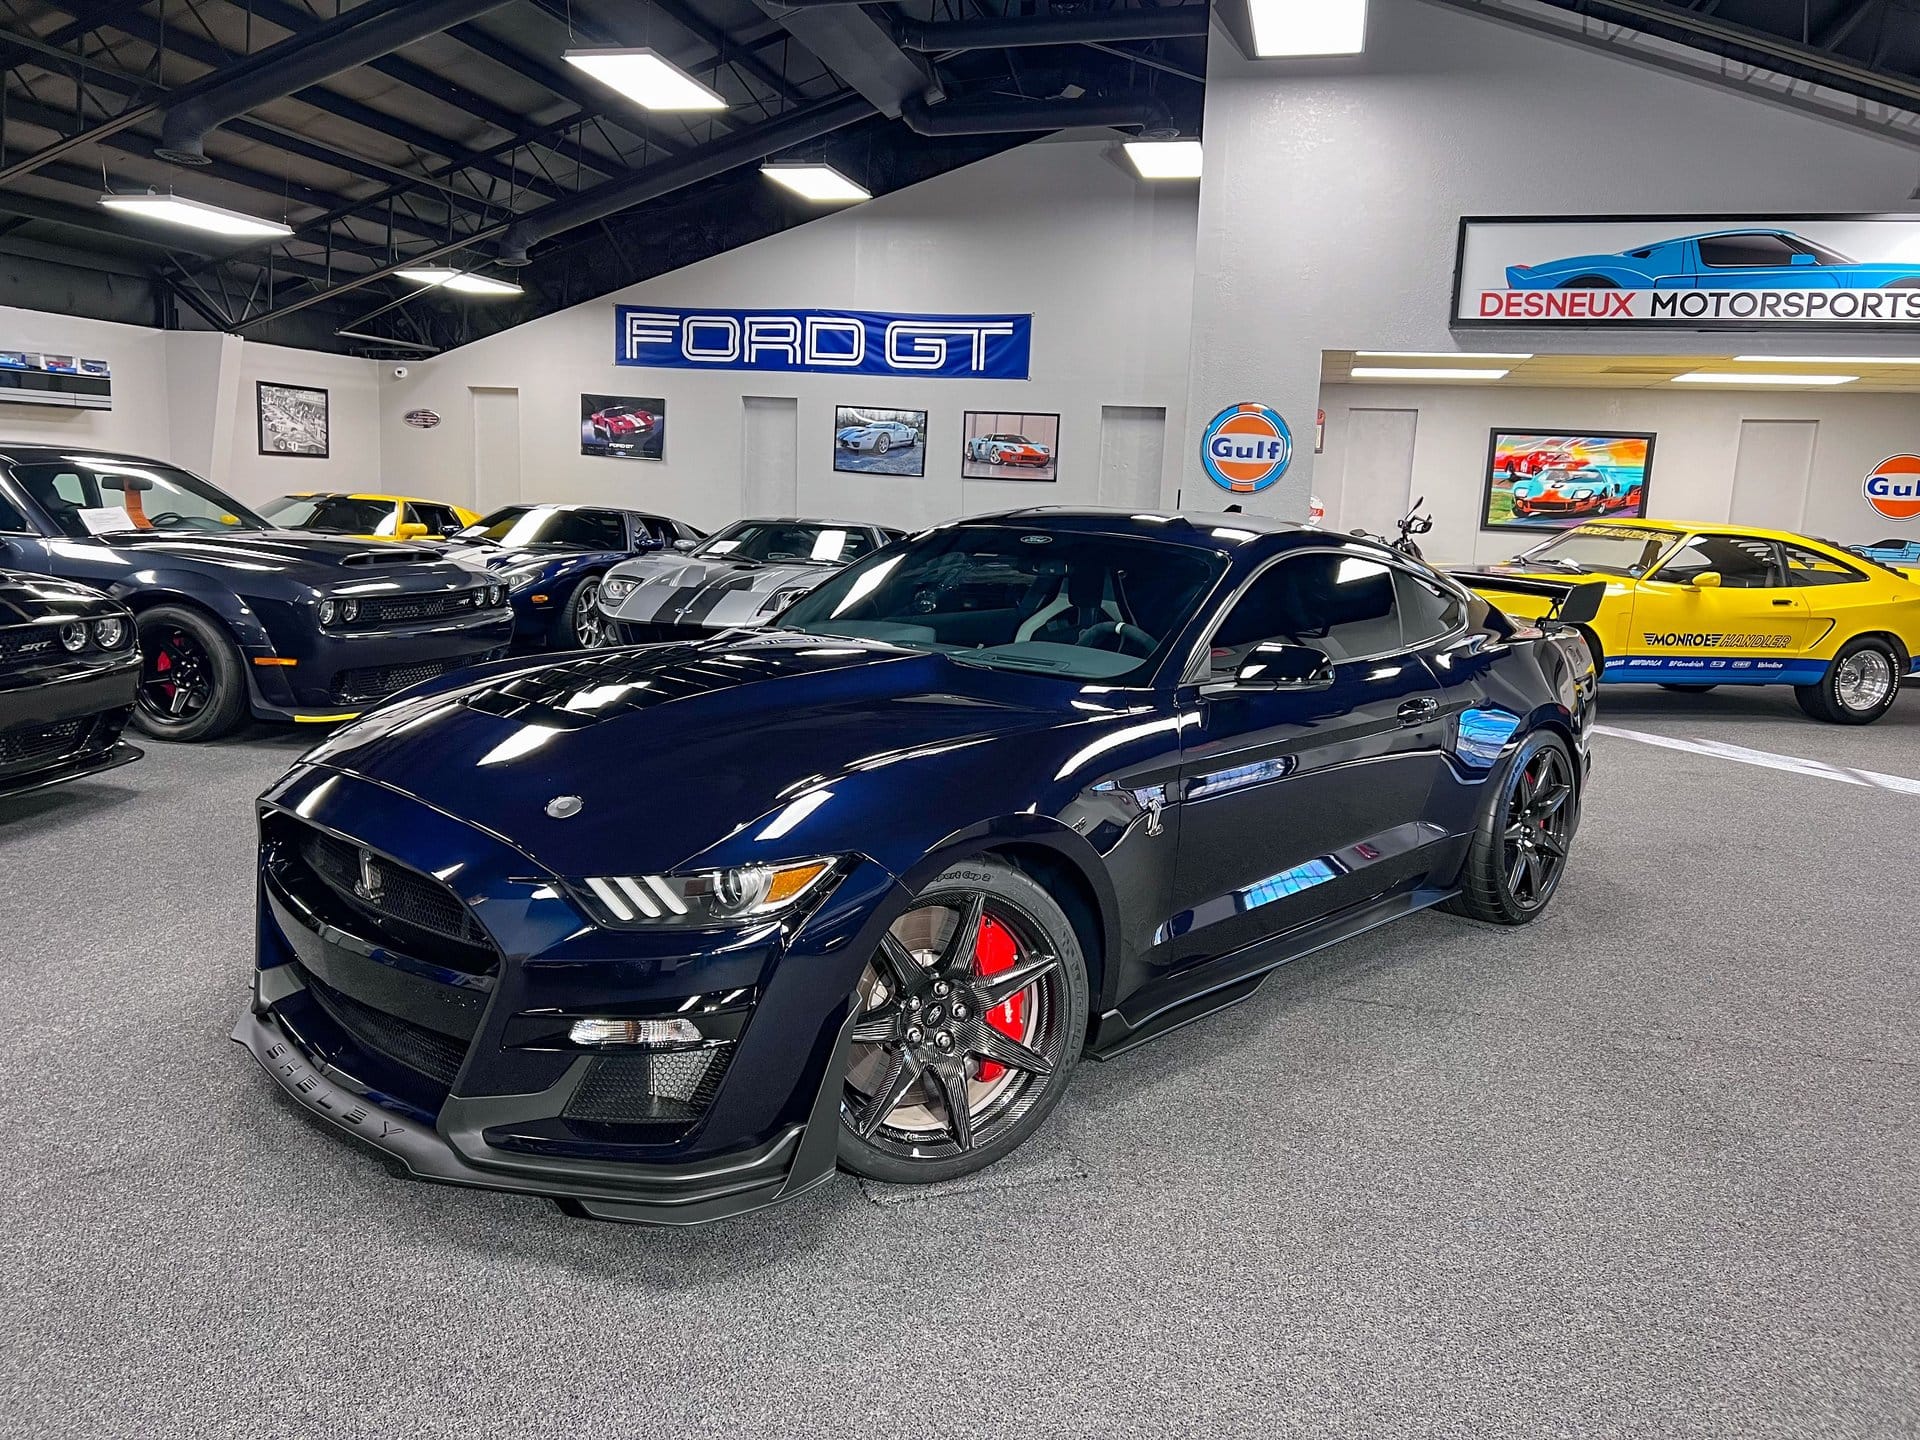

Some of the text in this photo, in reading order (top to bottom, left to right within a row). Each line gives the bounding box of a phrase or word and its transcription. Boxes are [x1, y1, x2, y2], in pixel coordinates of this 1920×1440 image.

[1479, 291, 1920, 318] DESNEUX MOTORSPORTS
[625, 312, 1014, 371] FORD GT
[1211, 437, 1281, 460] Gulf
[1867, 476, 1920, 497] Gul
[18, 640, 52, 653] SRT
[1652, 633, 1792, 648] MONROE HANDLER
[1668, 660, 1704, 668] BFGoodrich
[936, 870, 991, 883] port Cup 2
[266, 1042, 406, 1139] SHELBY
